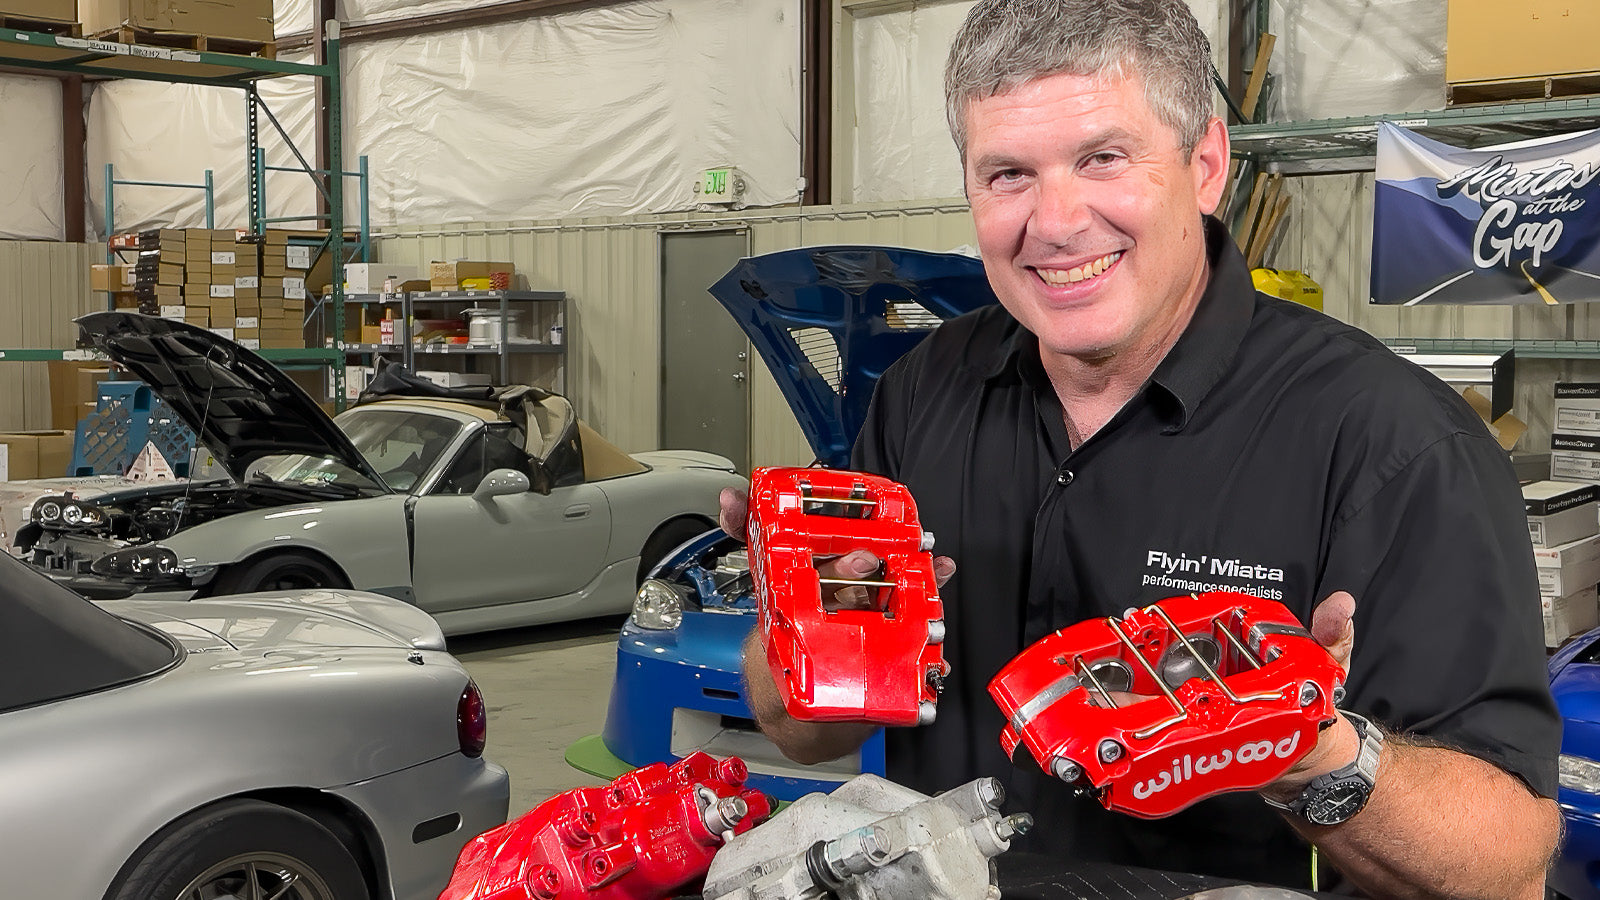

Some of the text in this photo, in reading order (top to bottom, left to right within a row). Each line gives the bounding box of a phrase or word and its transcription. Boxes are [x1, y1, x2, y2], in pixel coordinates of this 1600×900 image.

[1436, 155, 1600, 203] Miatas
[1522, 192, 1586, 216] at the
[1473, 199, 1564, 268] Gap
[1146, 550, 1284, 582] Flyin' Miata
[1132, 730, 1302, 800] wilwood
